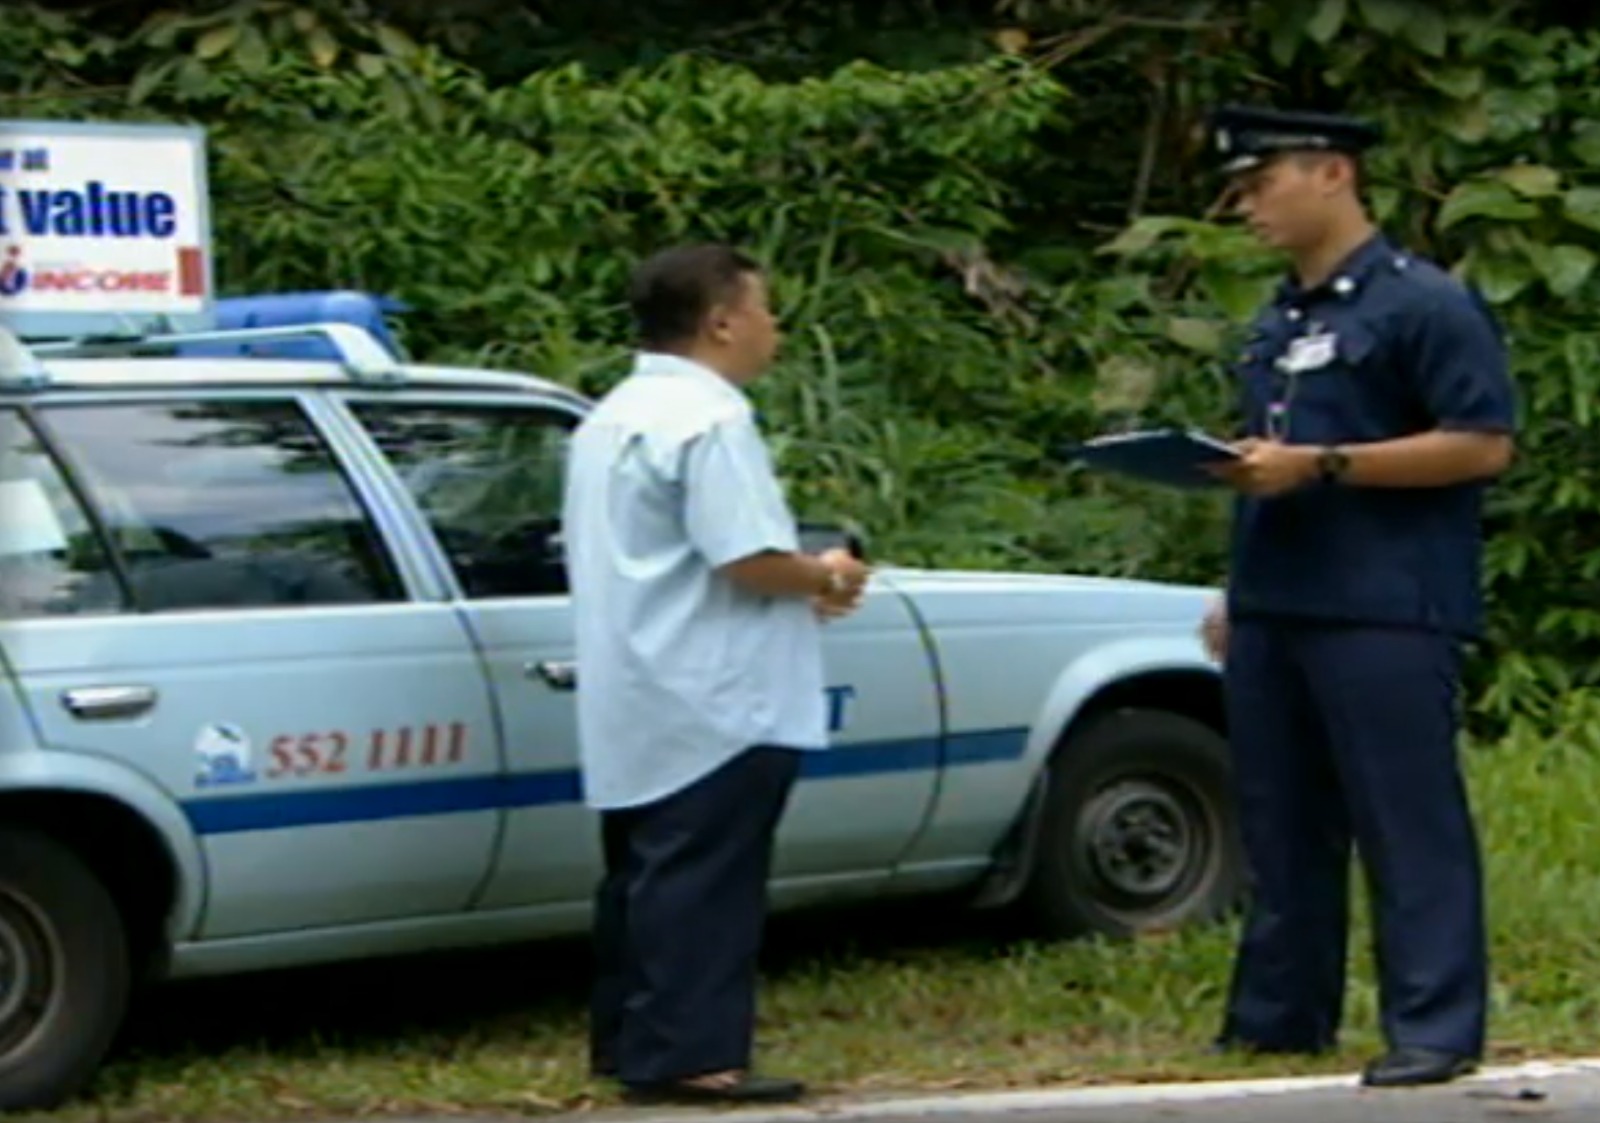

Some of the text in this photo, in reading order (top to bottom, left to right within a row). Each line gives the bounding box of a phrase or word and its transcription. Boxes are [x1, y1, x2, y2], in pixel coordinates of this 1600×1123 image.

[18, 181, 176, 238] value
[32, 271, 171, 291] INCOME
[267, 722, 466, 778] 552 1111
